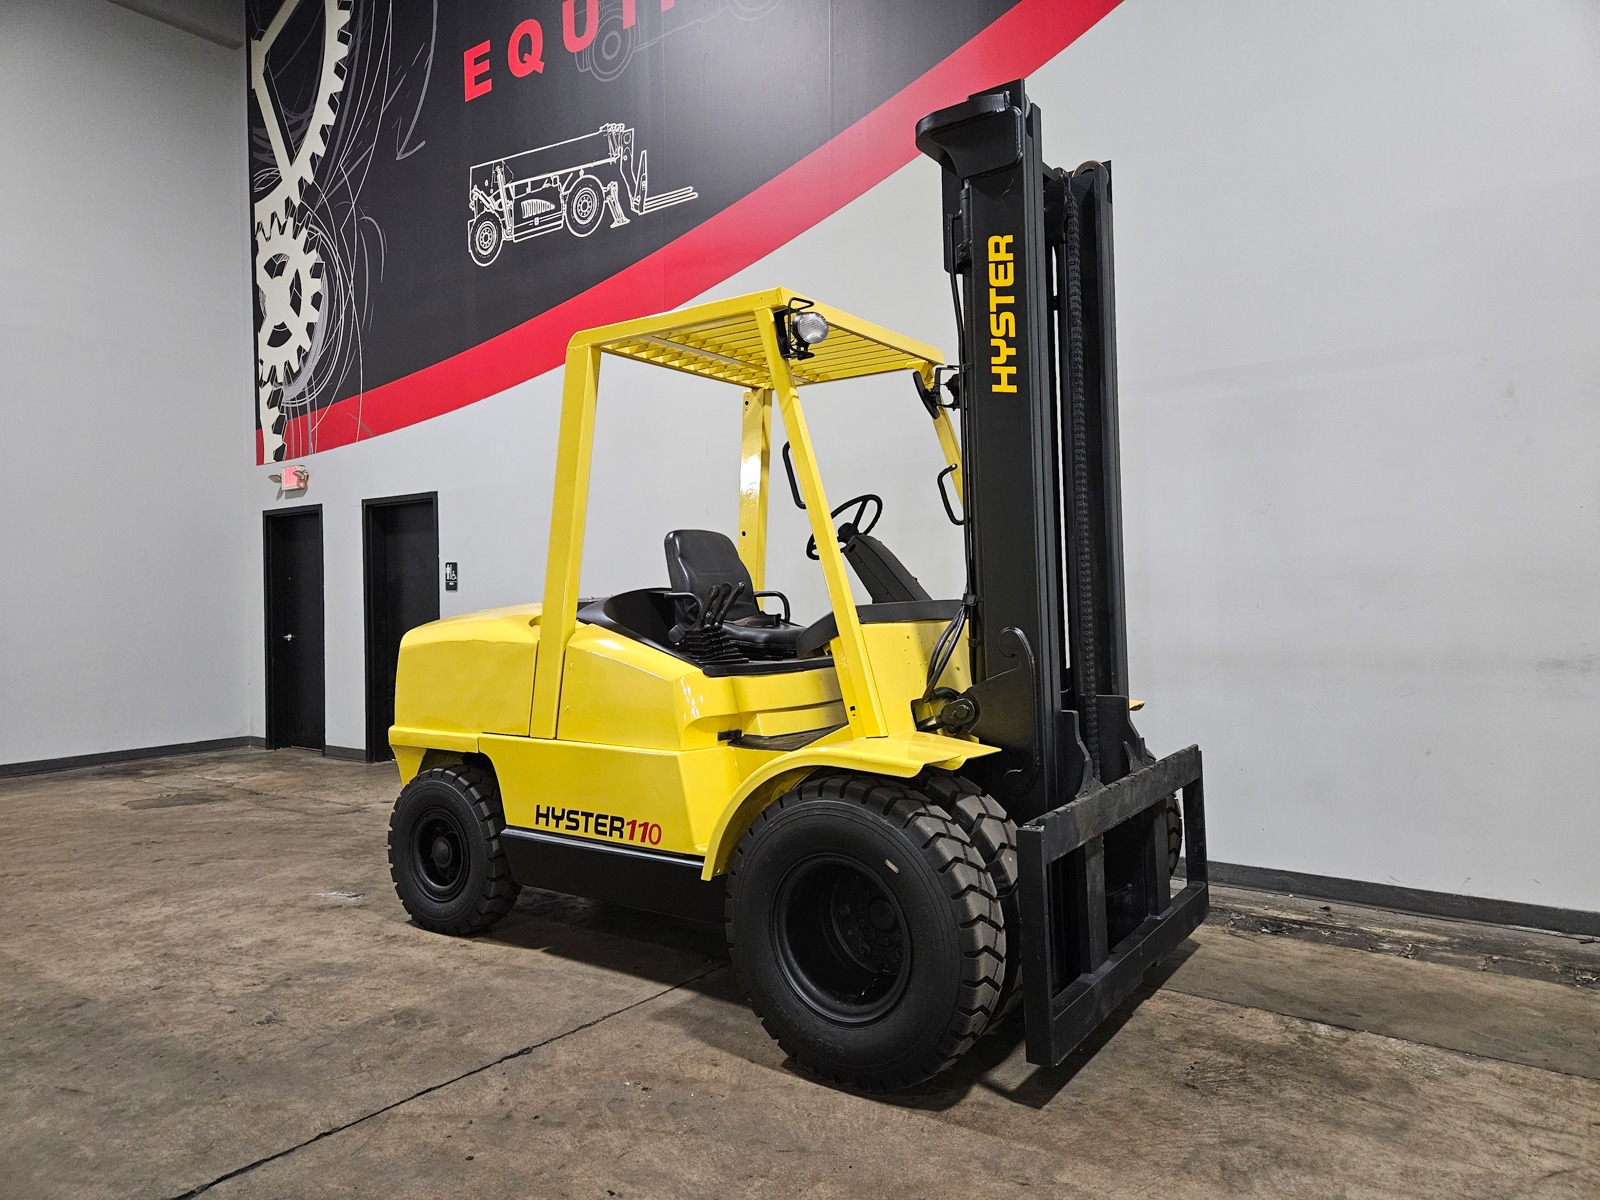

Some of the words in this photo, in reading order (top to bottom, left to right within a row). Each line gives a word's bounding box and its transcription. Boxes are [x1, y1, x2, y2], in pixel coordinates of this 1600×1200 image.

[463, 0, 675, 102] EQU
[987, 234, 1018, 393] HYSTER
[535, 804, 625, 839] HYSTER
[626, 819, 662, 846] 110
